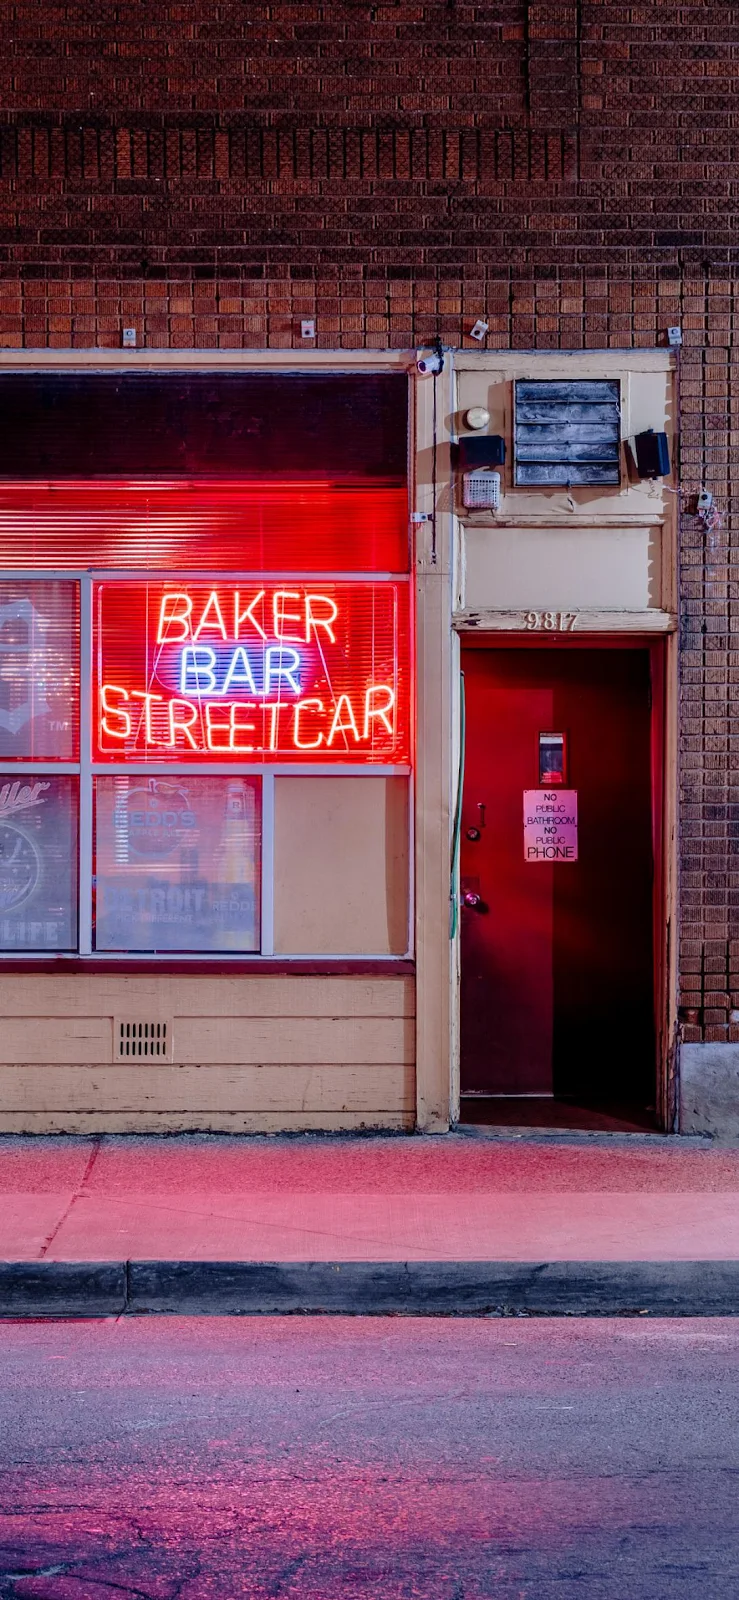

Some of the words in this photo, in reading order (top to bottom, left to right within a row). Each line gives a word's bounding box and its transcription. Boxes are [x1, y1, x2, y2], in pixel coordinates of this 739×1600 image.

[157, 590, 338, 643] BAKER
[526, 611, 579, 631] 9817
[179, 646, 302, 695] BAR
[101, 684, 395, 751] STREETCAR
[49, 720, 68, 731] TM
[0, 781, 51, 810] ller
[543, 793, 558, 801] NO
[535, 804, 566, 812] PUBLIC
[527, 816, 575, 824] BATHROOM
[543, 826, 558, 834] NO
[535, 836, 566, 844] PUBLIC
[527, 846, 575, 858] PHONE
[104, 887, 205, 912] DETROIT
